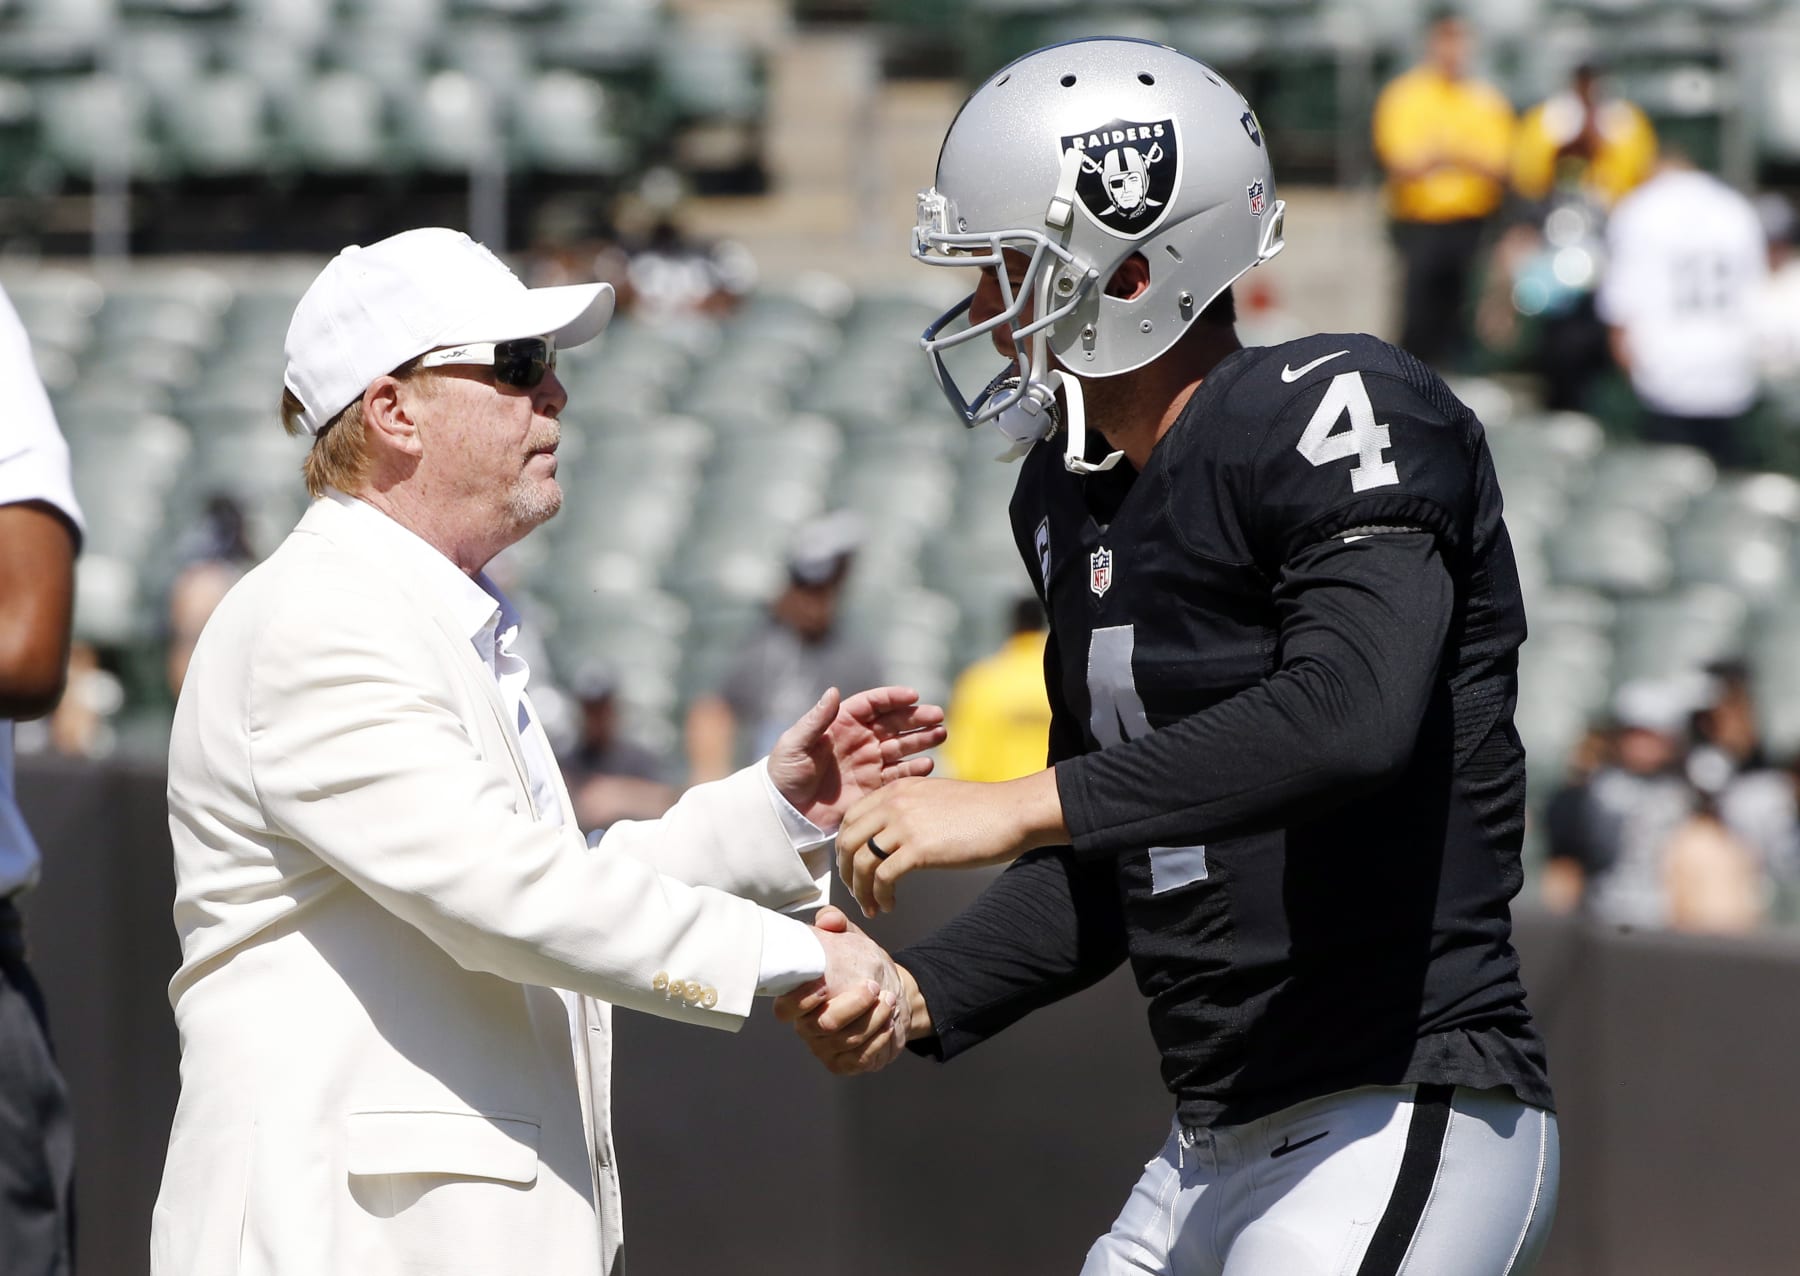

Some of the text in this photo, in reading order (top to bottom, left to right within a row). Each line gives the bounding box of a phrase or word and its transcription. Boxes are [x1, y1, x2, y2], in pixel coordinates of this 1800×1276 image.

[1072, 124, 1165, 150] RAIDERS
[1251, 195, 1265, 213] NFL
[1296, 370, 1400, 493] 4
[1094, 569, 1109, 588] NFL
